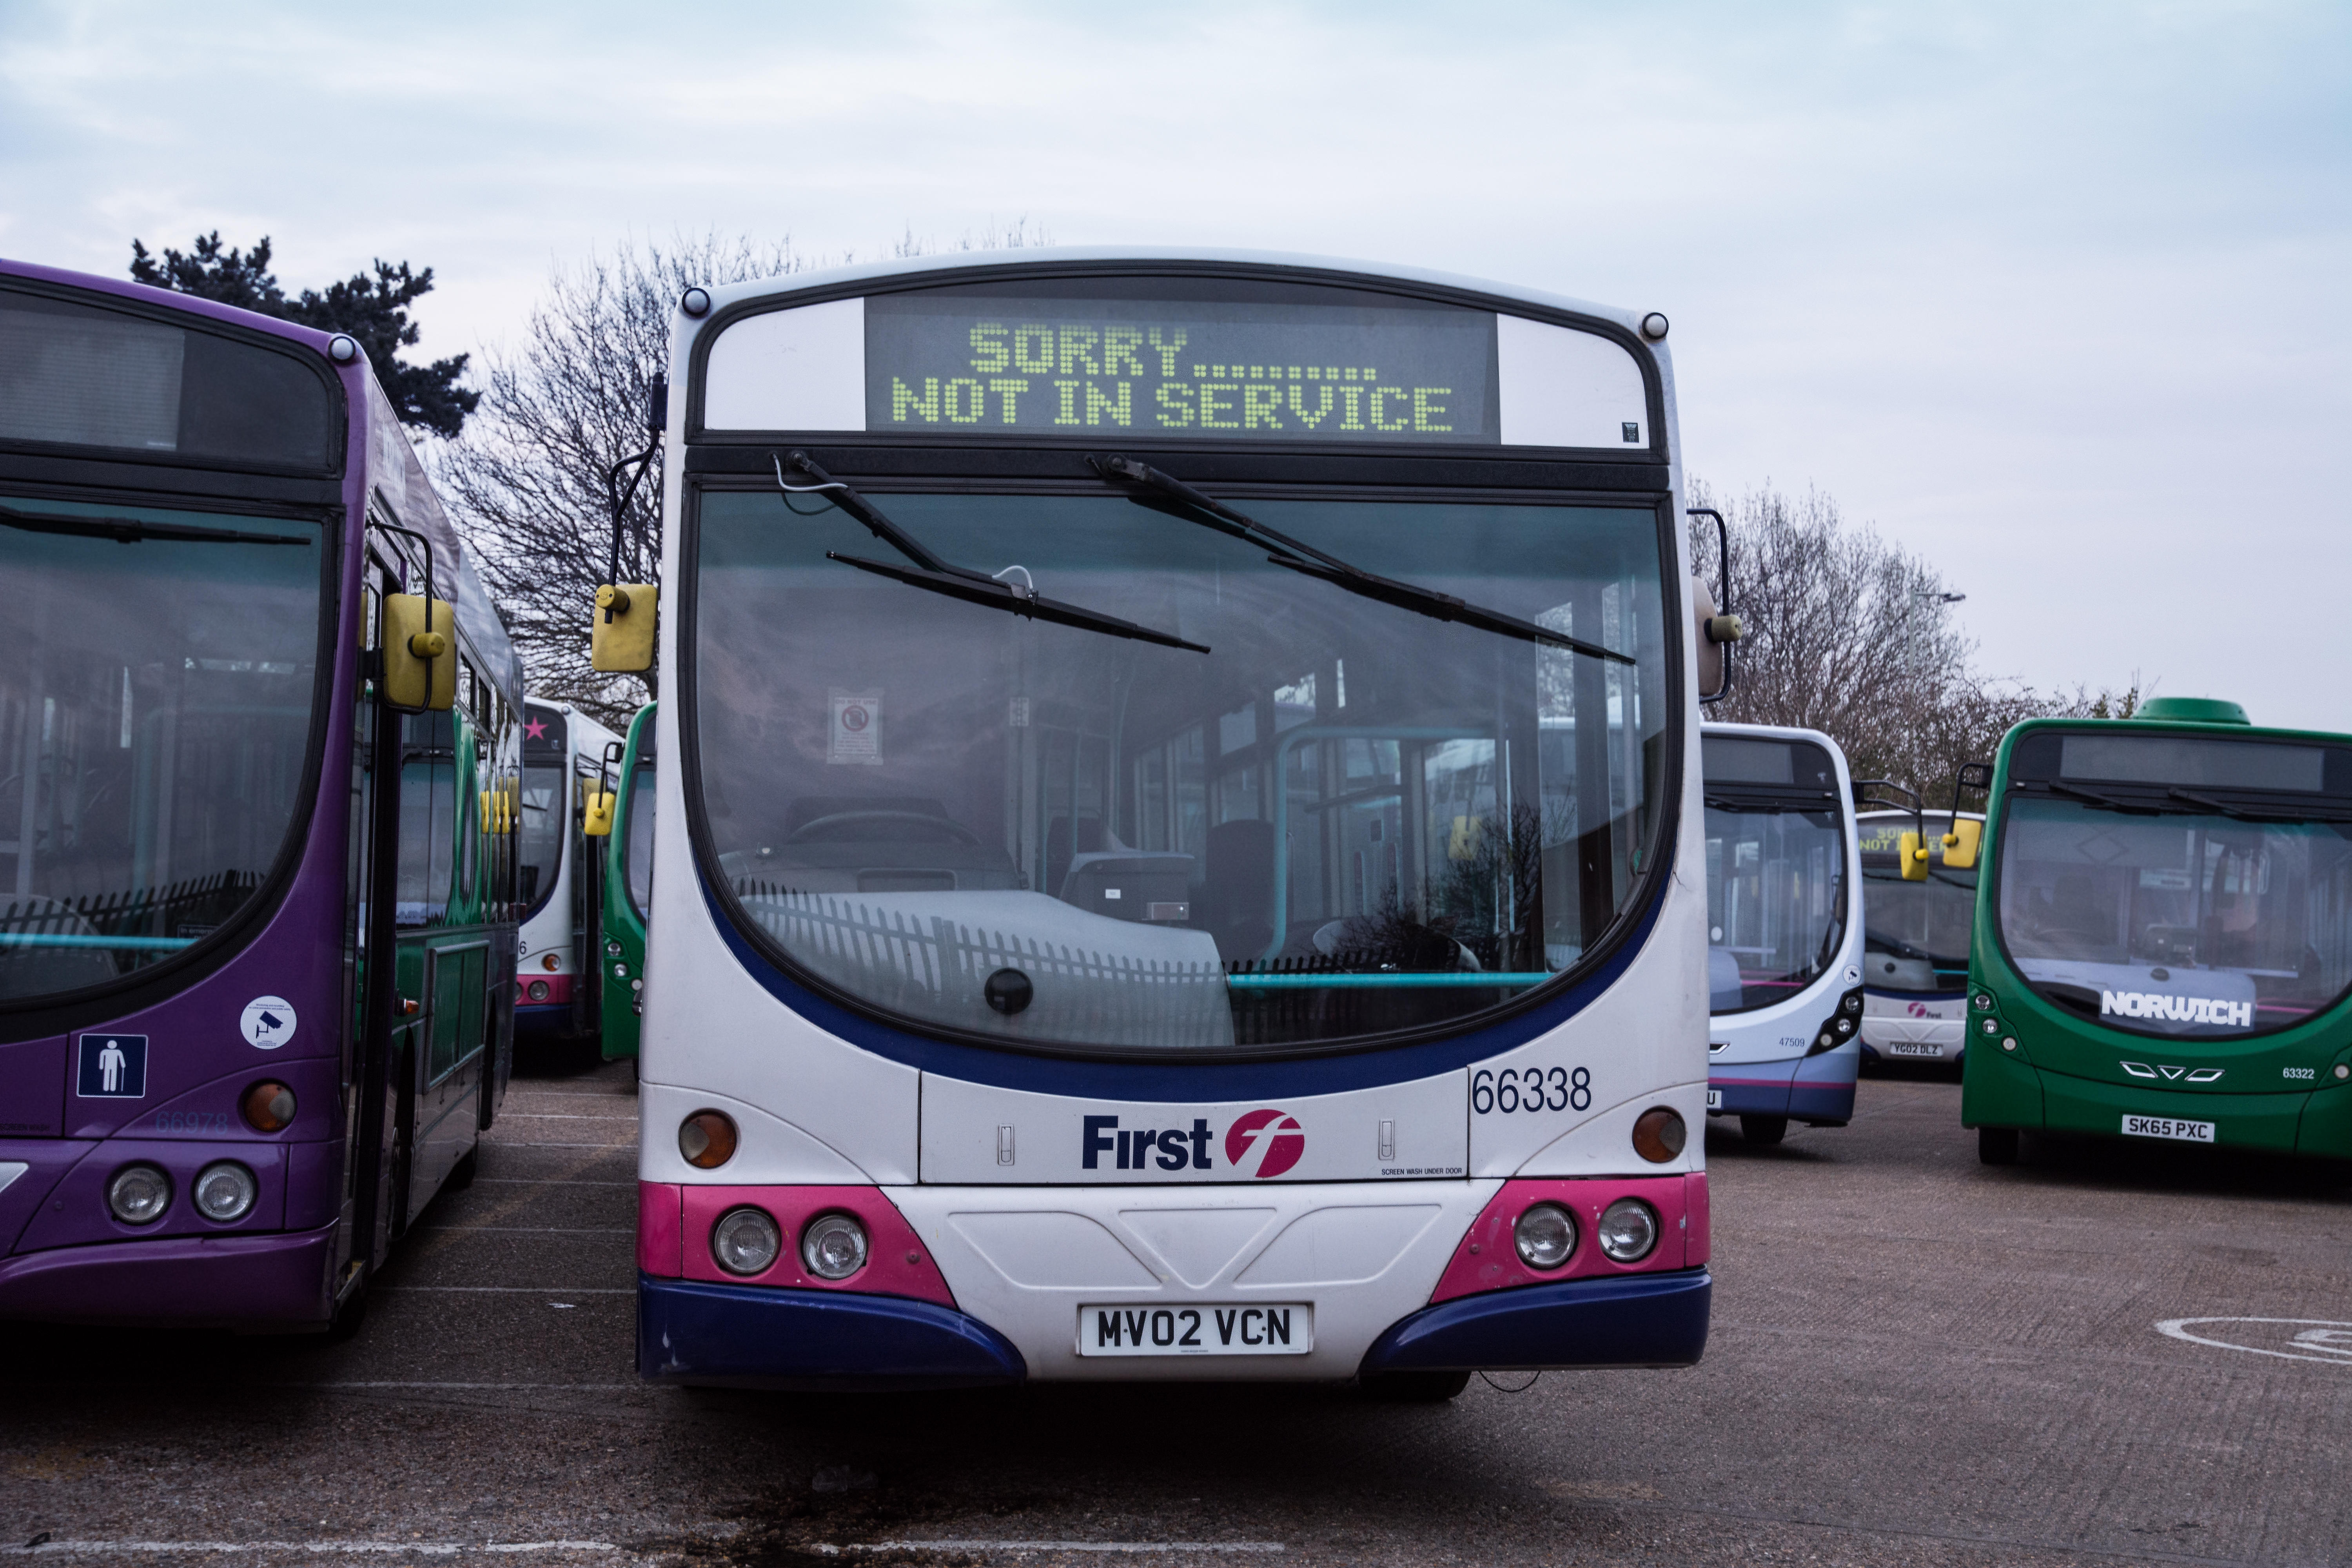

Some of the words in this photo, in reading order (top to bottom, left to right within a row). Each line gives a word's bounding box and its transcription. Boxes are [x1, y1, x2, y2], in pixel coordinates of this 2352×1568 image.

[892, 376, 1029, 423] NOT
[1054, 380, 1131, 426] IN
[1155, 383, 1453, 432] SERVICE
[1859, 838, 1890, 851] NOT
[2101, 990, 2251, 1027] NORWICH
[1779, 1037, 1805, 1047] 47509
[2283, 1067, 2315, 1080] 63322
[1472, 1067, 1592, 1114] 66338
[156, 1111, 228, 1135] 66978
[2129, 1118, 2171, 1135] SK65
[2176, 1122, 2208, 1139] PXC
[1082, 1115, 1213, 1171] First
[1098, 1310, 1201, 1347] MV02
[1214, 1309, 1290, 1345] VCN
